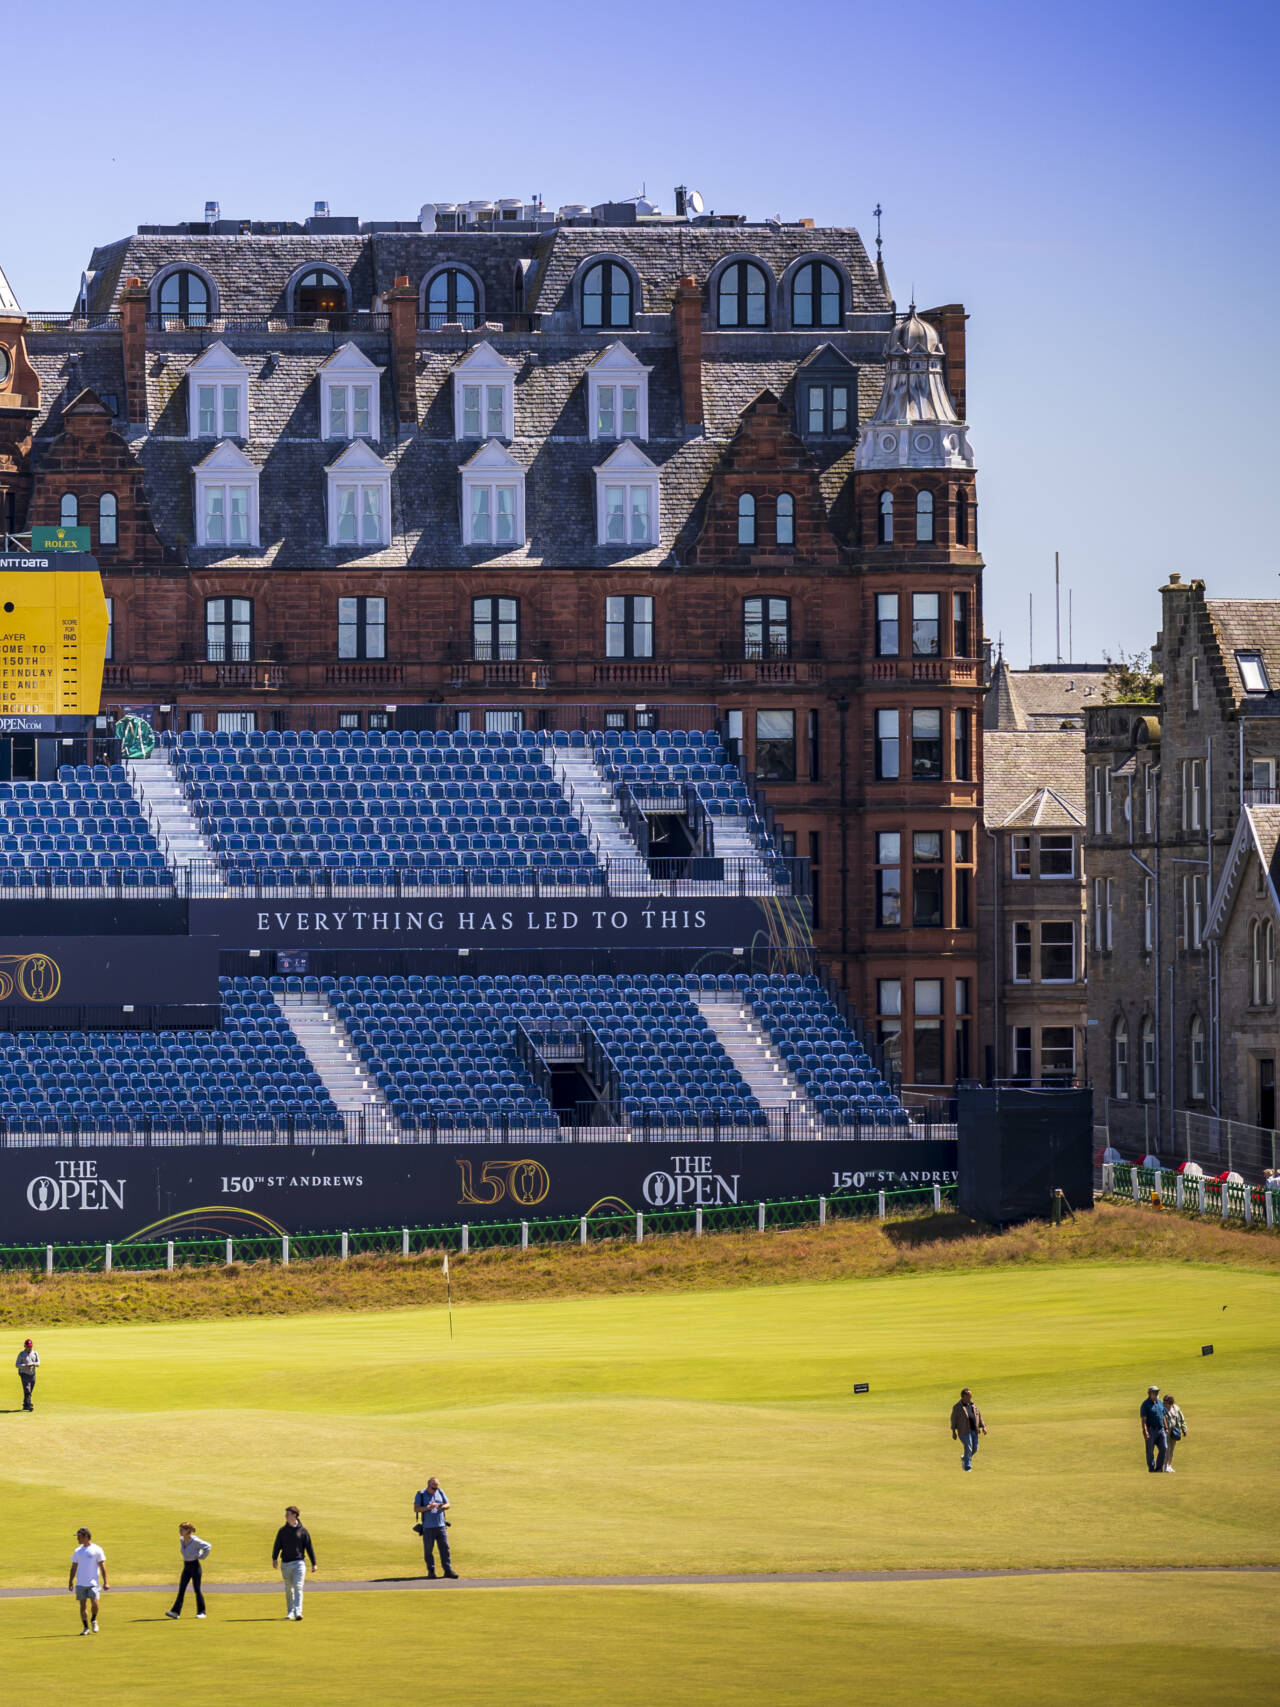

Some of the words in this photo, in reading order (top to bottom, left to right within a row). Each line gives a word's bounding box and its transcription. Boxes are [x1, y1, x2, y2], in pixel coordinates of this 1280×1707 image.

[44, 540, 78, 548] ROLEX
[0, 558, 20, 568] NTT
[32, 645, 47, 654] TO
[3, 657, 39, 666] 150TH
[3, 669, 53, 678] FINDLAY
[17, 681, 39, 689] AND
[257, 911, 445, 930] EVERYTHING
[458, 911, 513, 930] HAS
[527, 911, 578, 929] LED
[592, 910, 628, 929] TO
[641, 909, 706, 929] THIS
[54, 1160, 98, 1179] THE
[670, 1156, 713, 1174] THE
[267, 1176, 285, 1187] ST
[289, 1175, 363, 1187] ANDREWS
[456, 1158, 551, 1206] 150
[877, 1171, 895, 1182] ST
[26, 1175, 127, 1212] OPEN
[642, 1170, 741, 1206] OPEN
